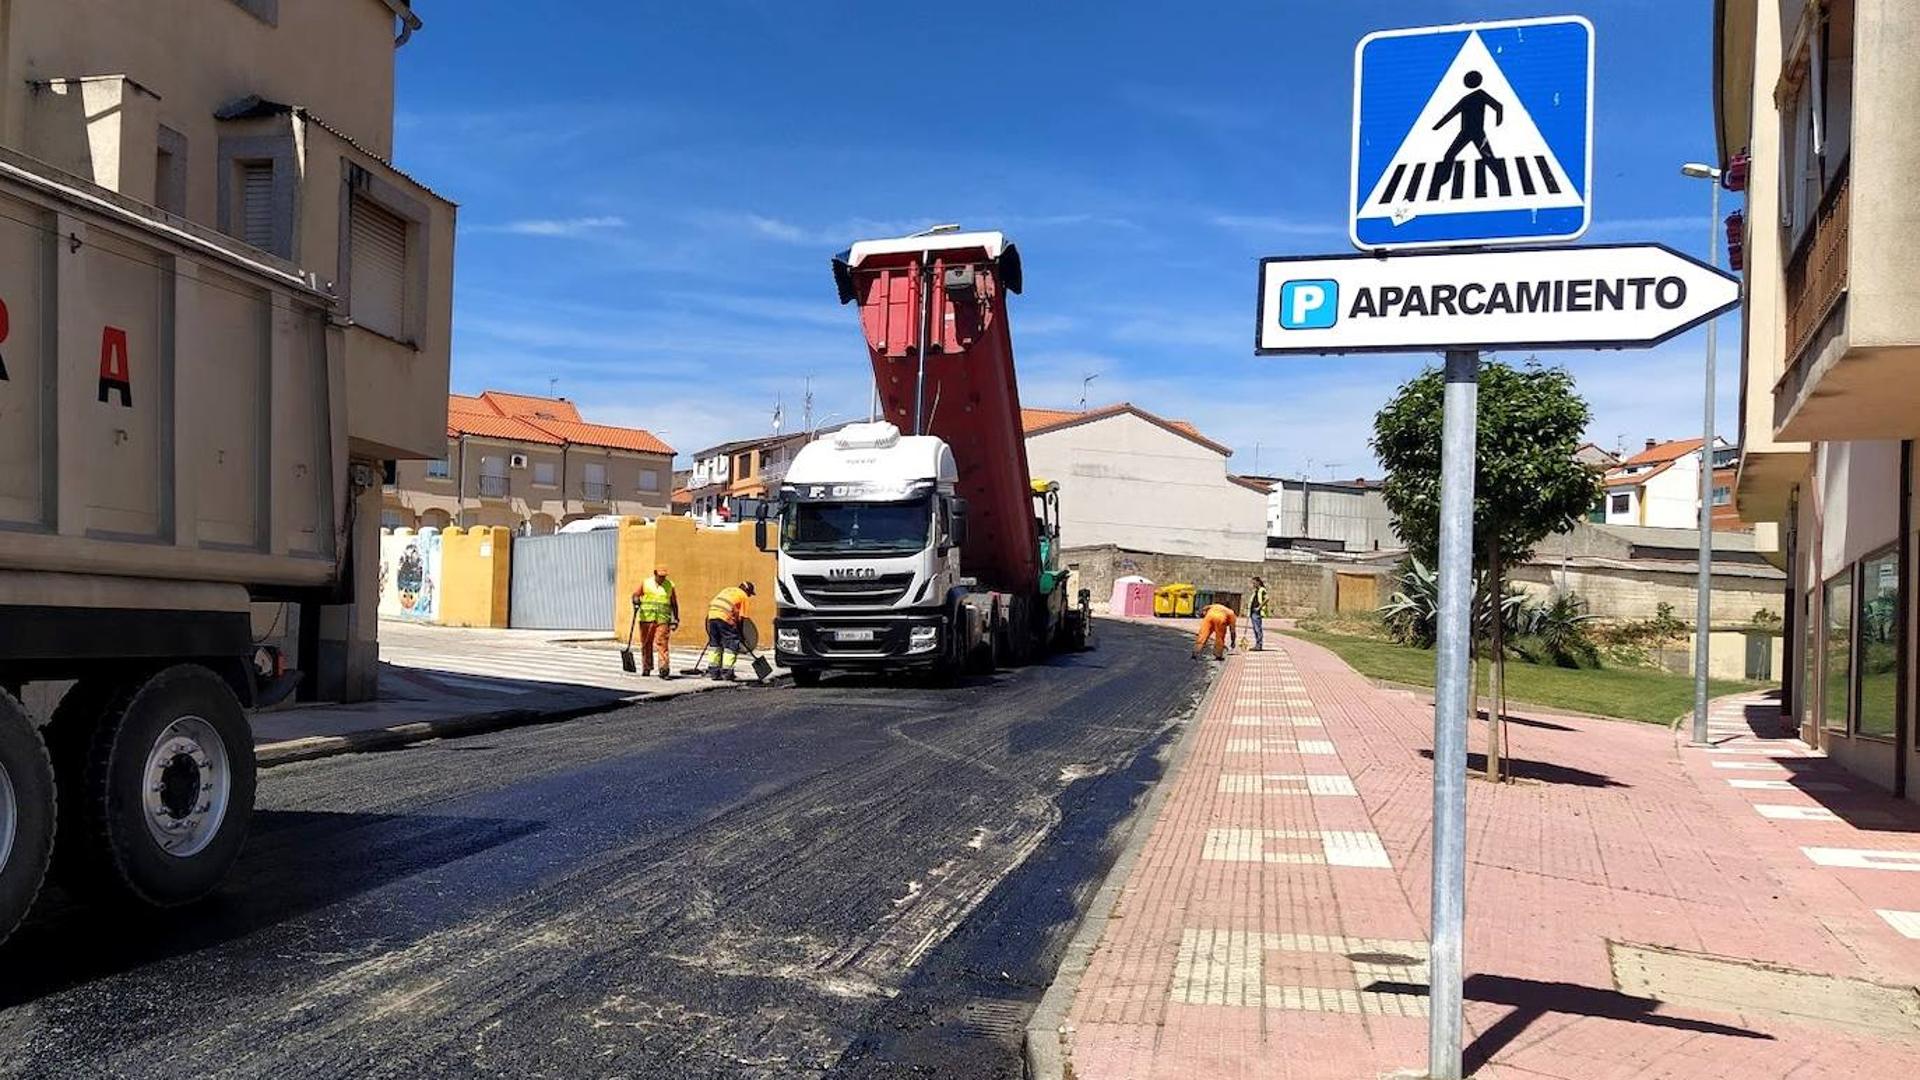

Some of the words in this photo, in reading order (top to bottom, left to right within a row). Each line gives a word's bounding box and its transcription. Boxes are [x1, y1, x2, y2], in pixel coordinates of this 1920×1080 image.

[1293, 285, 1325, 325] P
[1349, 275, 1687, 319] APARCAMIENTO
[829, 568, 876, 580] IVECO
